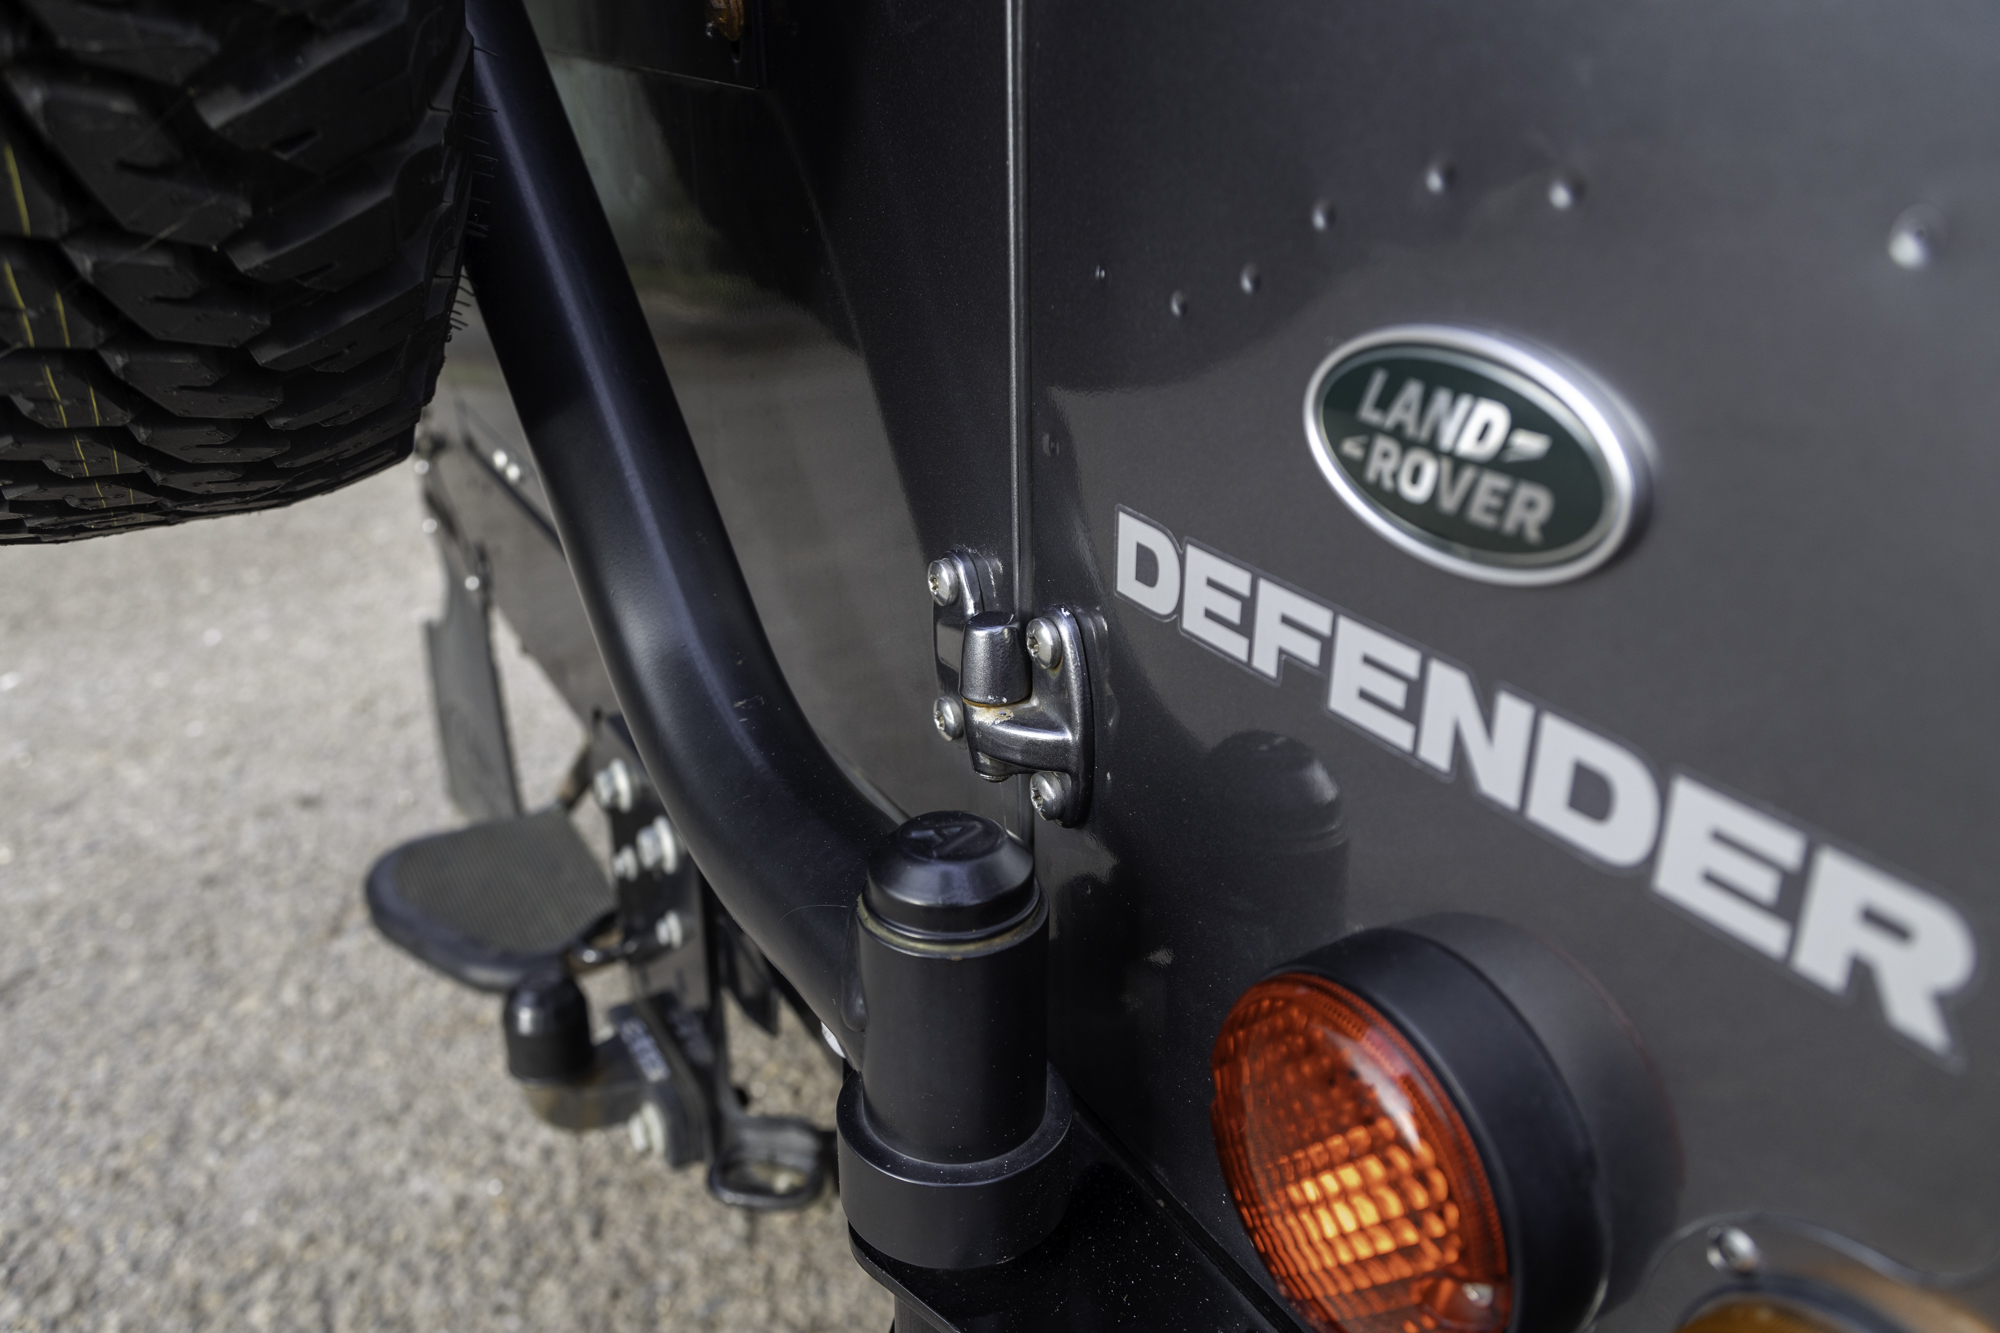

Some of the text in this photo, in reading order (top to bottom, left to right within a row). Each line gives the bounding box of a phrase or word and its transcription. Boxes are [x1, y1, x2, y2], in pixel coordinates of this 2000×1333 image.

[1356, 366, 1511, 463] LAND
[1364, 432, 1555, 545] ROVER
[1116, 509, 1975, 1054] DEFENDER
